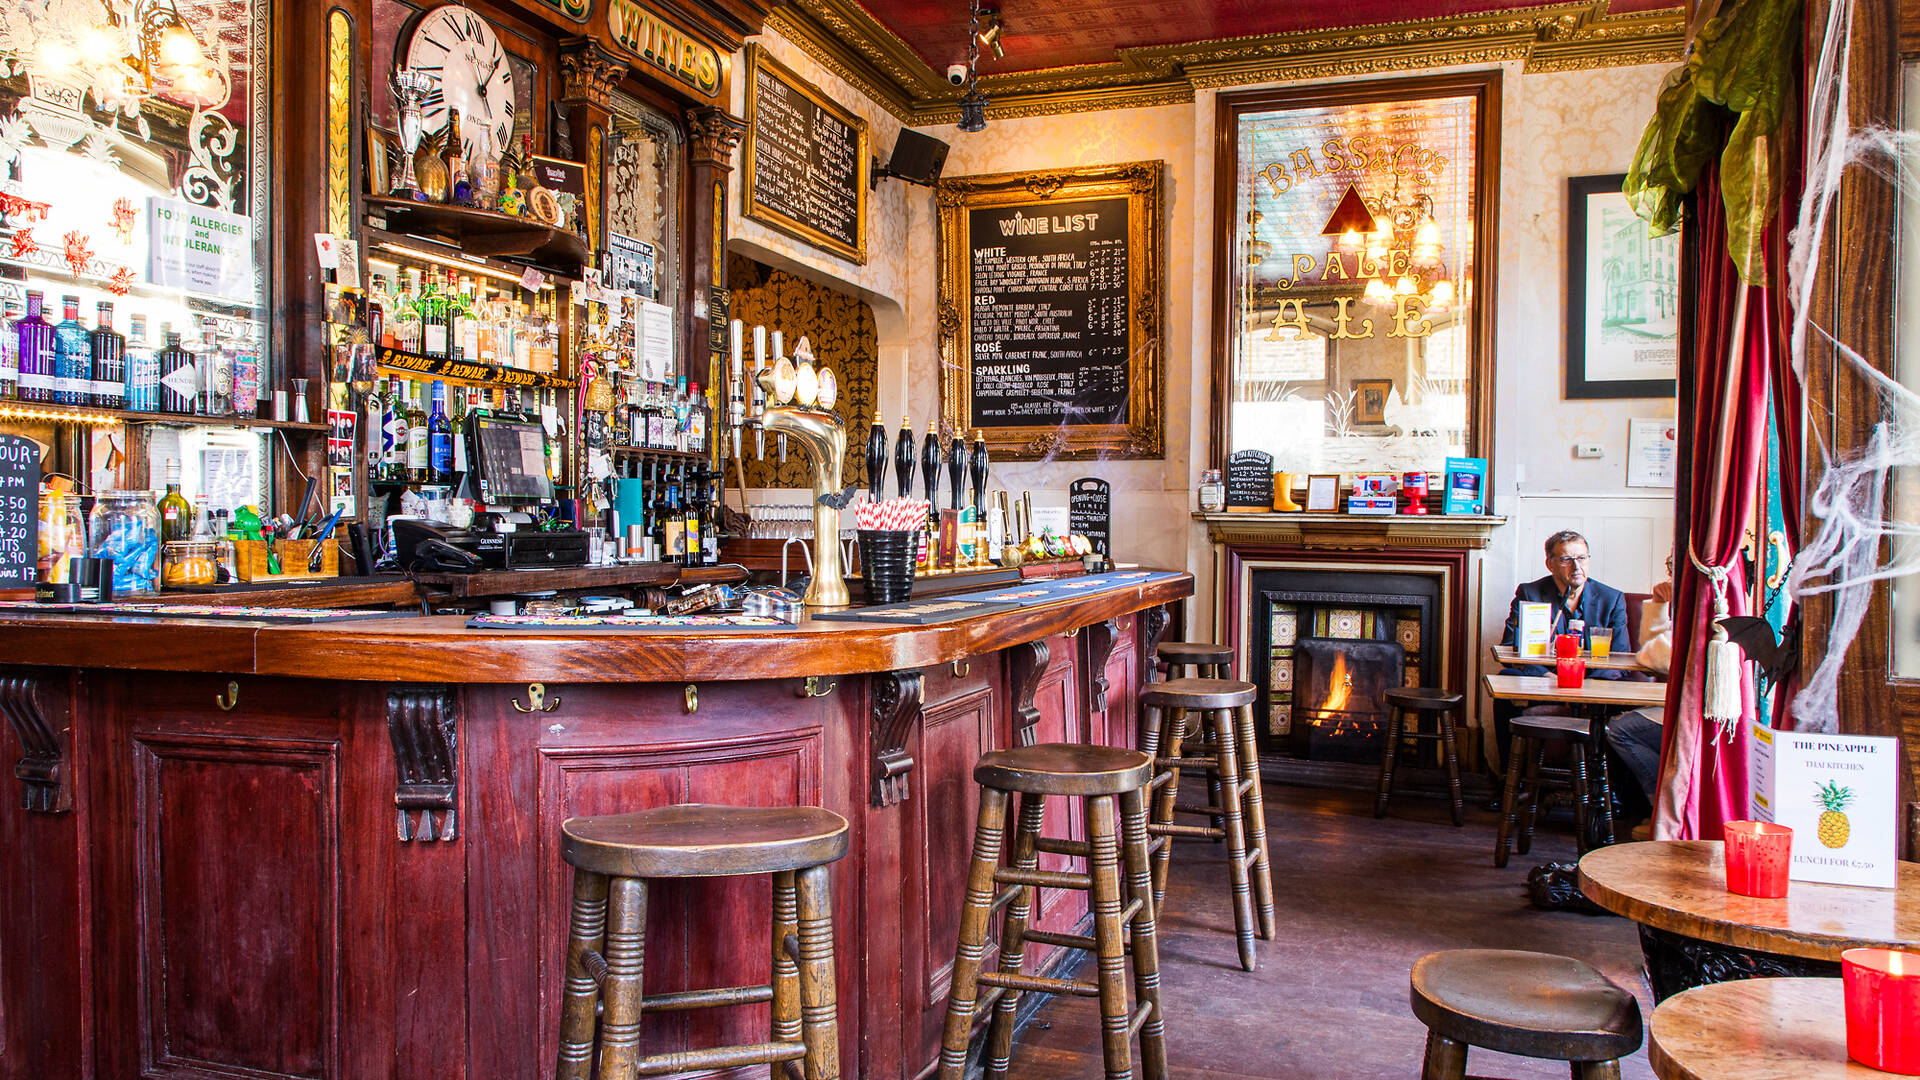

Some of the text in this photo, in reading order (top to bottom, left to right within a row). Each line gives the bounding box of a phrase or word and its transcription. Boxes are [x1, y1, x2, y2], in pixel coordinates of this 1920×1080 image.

[615, 0, 714, 91] WINES
[1258, 137, 1371, 199] BASS
[190, 215, 244, 235] ALLERGIES
[999, 211, 1099, 236] WINE LIST
[194, 230, 209, 244] and
[612, 236, 643, 253] HALLOWEEN
[974, 246, 1007, 259] WHITE
[1277, 249, 1420, 290] PALE
[974, 294, 996, 306] RED
[1264, 294, 1434, 342] ALE
[974, 340, 1002, 353] ROSÉ
[390, 354, 436, 372] BEWARE
[976, 364, 1030, 376] SPARKLING
[450, 363, 489, 381] BEWARE
[503, 370, 537, 385] BEWARE
[8, 476, 25, 487] PM
[0, 538, 20, 552] ITS
[23, 567, 37, 581] 17
[1793, 741, 1878, 754] THE PINEAPPLE
[1806, 760, 1864, 771] THAI KITCHEN
[1794, 856, 1828, 865] LUNCH
[1830, 858, 1848, 867] FOR
